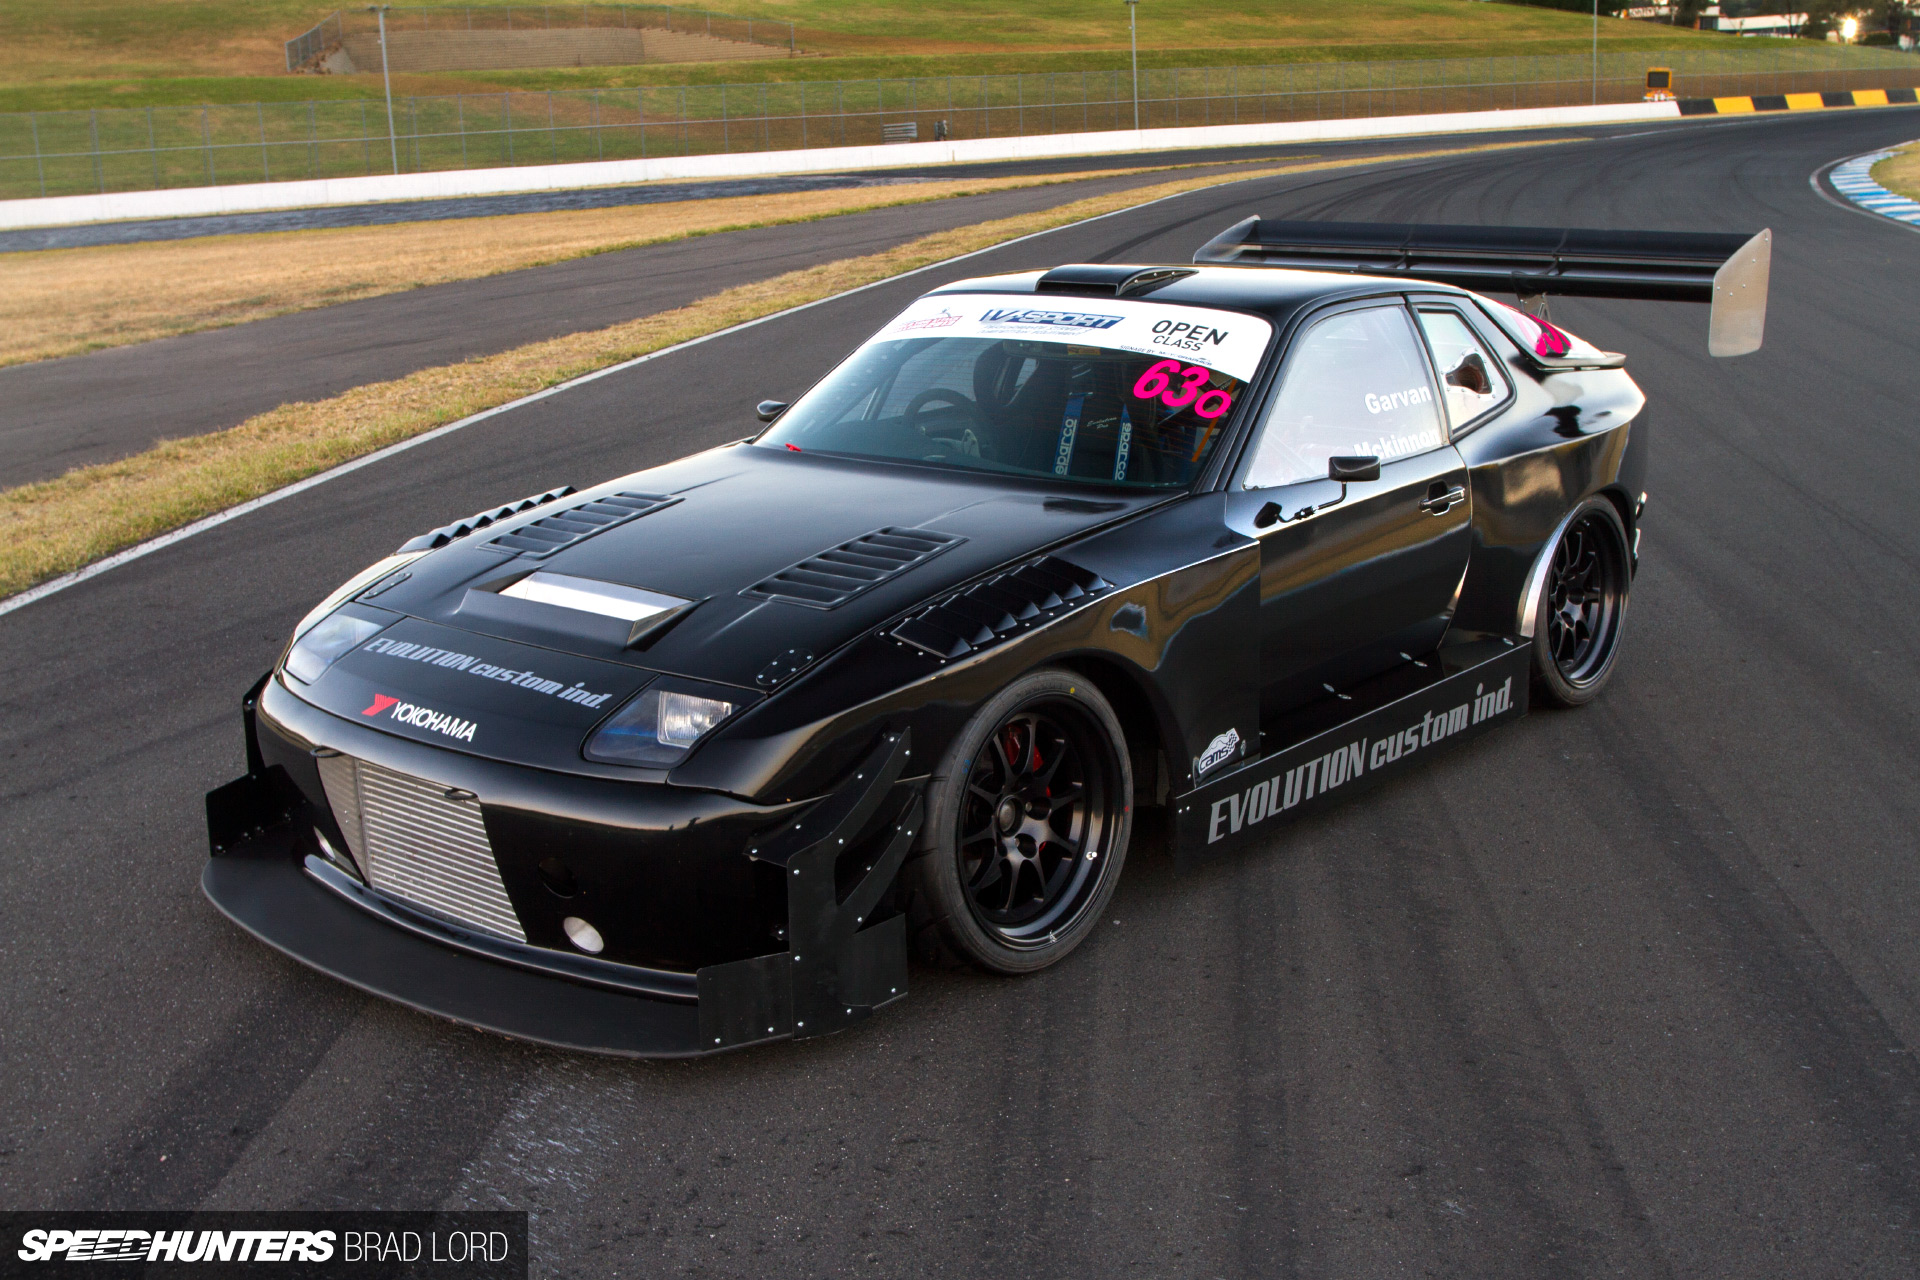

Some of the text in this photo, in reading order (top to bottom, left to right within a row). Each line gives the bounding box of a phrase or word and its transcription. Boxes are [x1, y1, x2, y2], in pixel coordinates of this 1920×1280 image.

[1152, 320, 1229, 345] OPEN
[1153, 335, 1203, 352] CLASS
[1365, 385, 1432, 414] Garvan
[1055, 418, 1075, 475] sparco
[1117, 422, 1132, 480] sparco
[363, 637, 613, 709] EVOLUTION custom ind.
[391, 701, 478, 743] YOKOHAMA
[1208, 676, 1514, 844] EVOLUTION custom ind.
